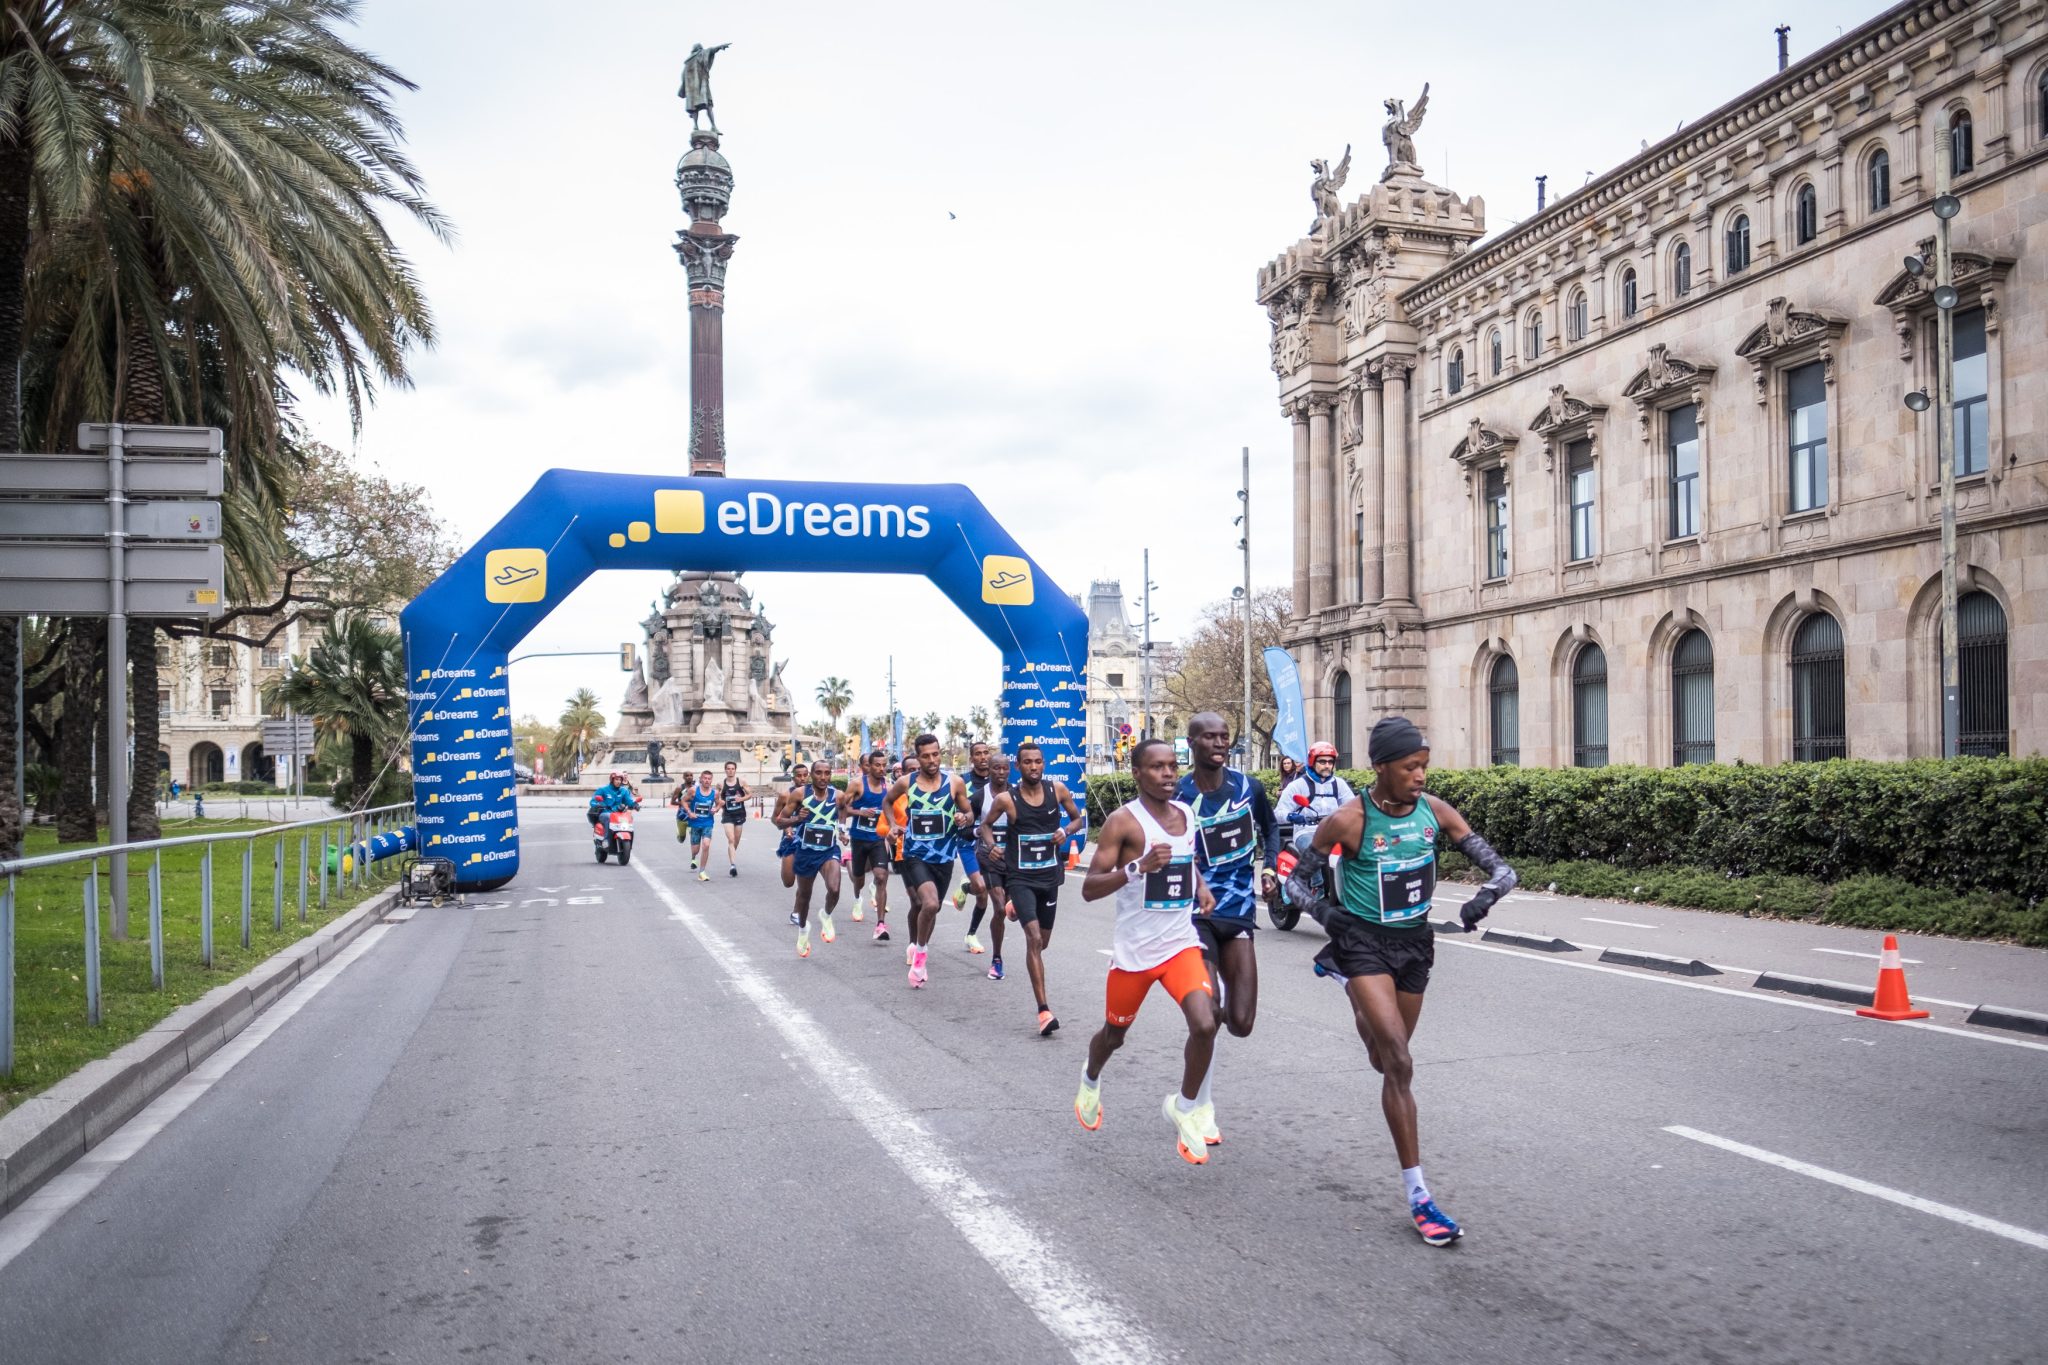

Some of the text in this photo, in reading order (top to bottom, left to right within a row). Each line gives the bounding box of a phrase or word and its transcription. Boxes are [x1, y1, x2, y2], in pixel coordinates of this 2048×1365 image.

[717, 492, 930, 538] eDreams
[1036, 663, 1071, 672] eDreams
[431, 669, 475, 679] eDreams
[473, 687, 506, 697] eDreams
[1035, 700, 1070, 709] eDreams
[434, 710, 478, 720] eDreams
[476, 728, 508, 739] eDreams
[1034, 736, 1069, 745] eDreams
[437, 752, 480, 761] eDreams
[478, 769, 511, 780] eDreams
[440, 793, 483, 802] eDreams
[481, 809, 513, 820] eDreams
[442, 834, 485, 844] eDreams
[1230, 838, 1237, 847] 4
[484, 850, 515, 861] eDreams
[1168, 884, 1181, 897] 42
[1408, 889, 1421, 904] 43
